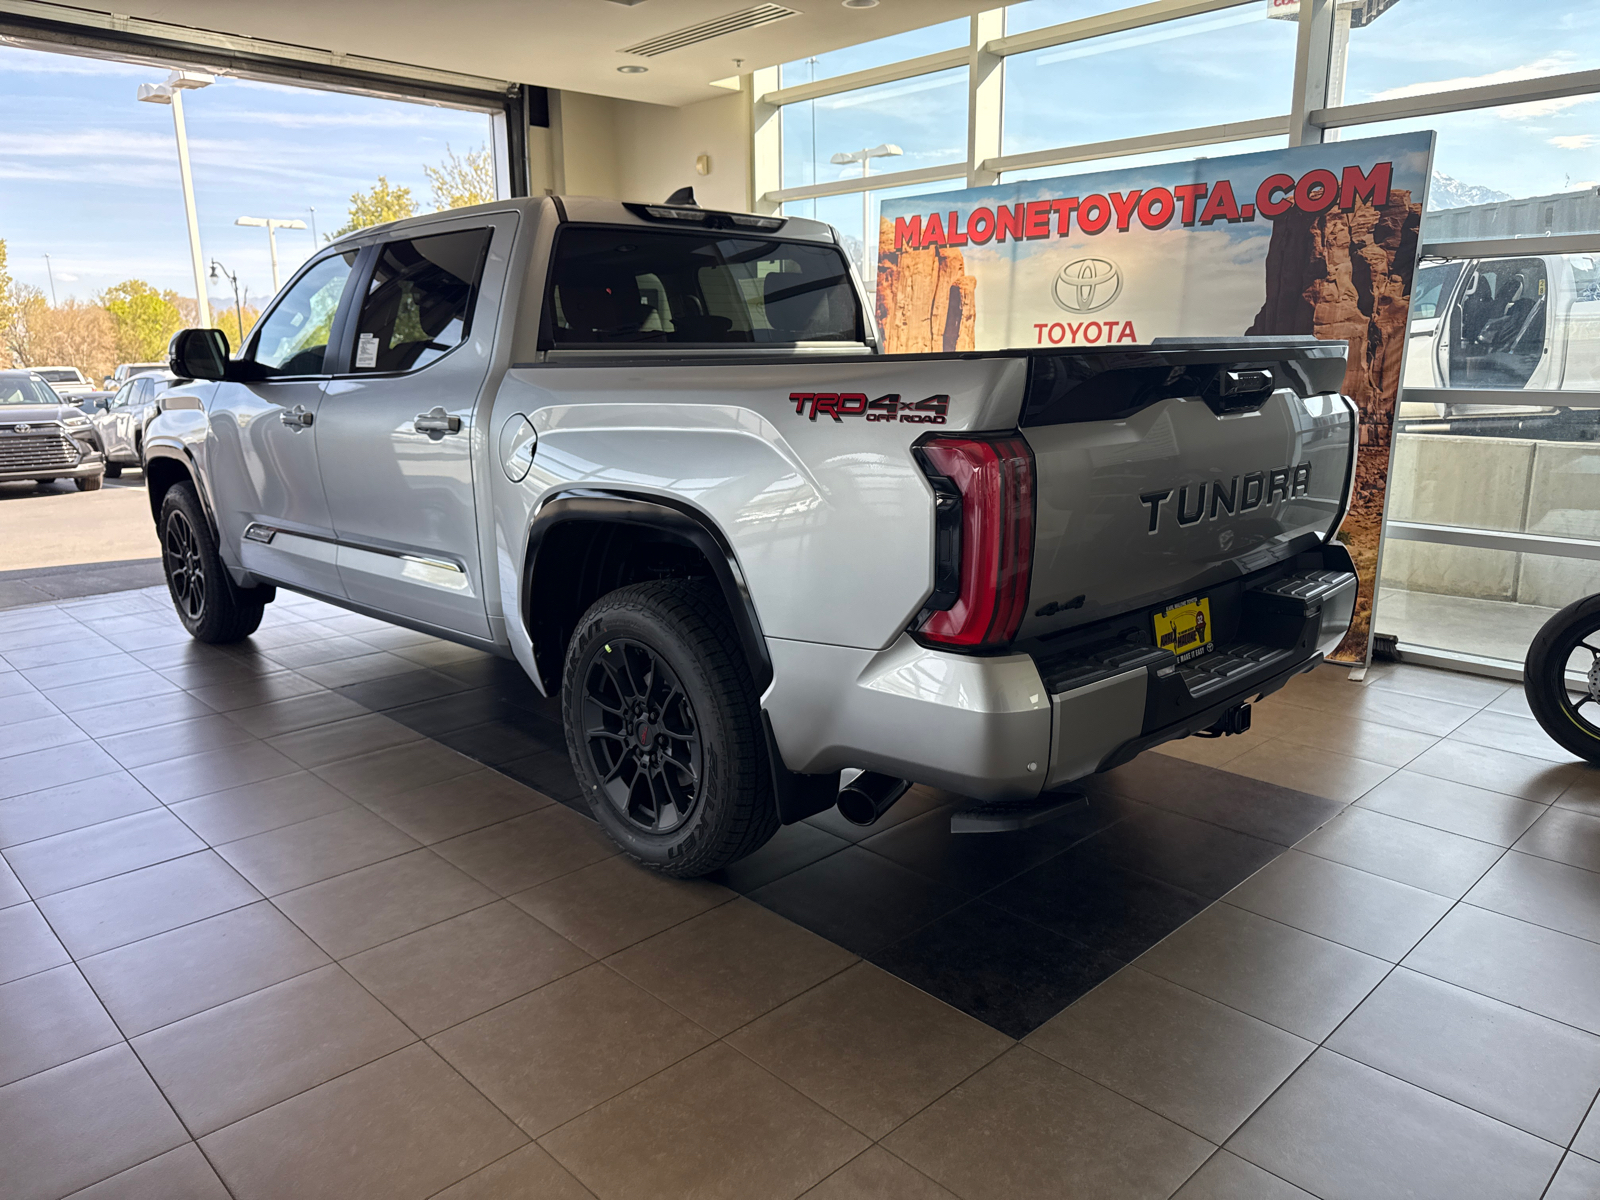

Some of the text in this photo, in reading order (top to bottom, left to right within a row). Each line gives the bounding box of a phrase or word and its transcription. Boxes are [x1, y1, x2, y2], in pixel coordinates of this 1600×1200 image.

[894, 162, 1394, 250] MALONETOYOTA.COM
[1033, 320, 1138, 345] TOYOTA
[789, 393, 869, 423] TRD
[866, 413, 948, 425] OFF ROAD
[1138, 461, 1312, 535] TUNDRA
[1197, 615, 1203, 624] 32
[1195, 646, 1205, 657] EASY
[667, 742, 718, 860] FALKEN
